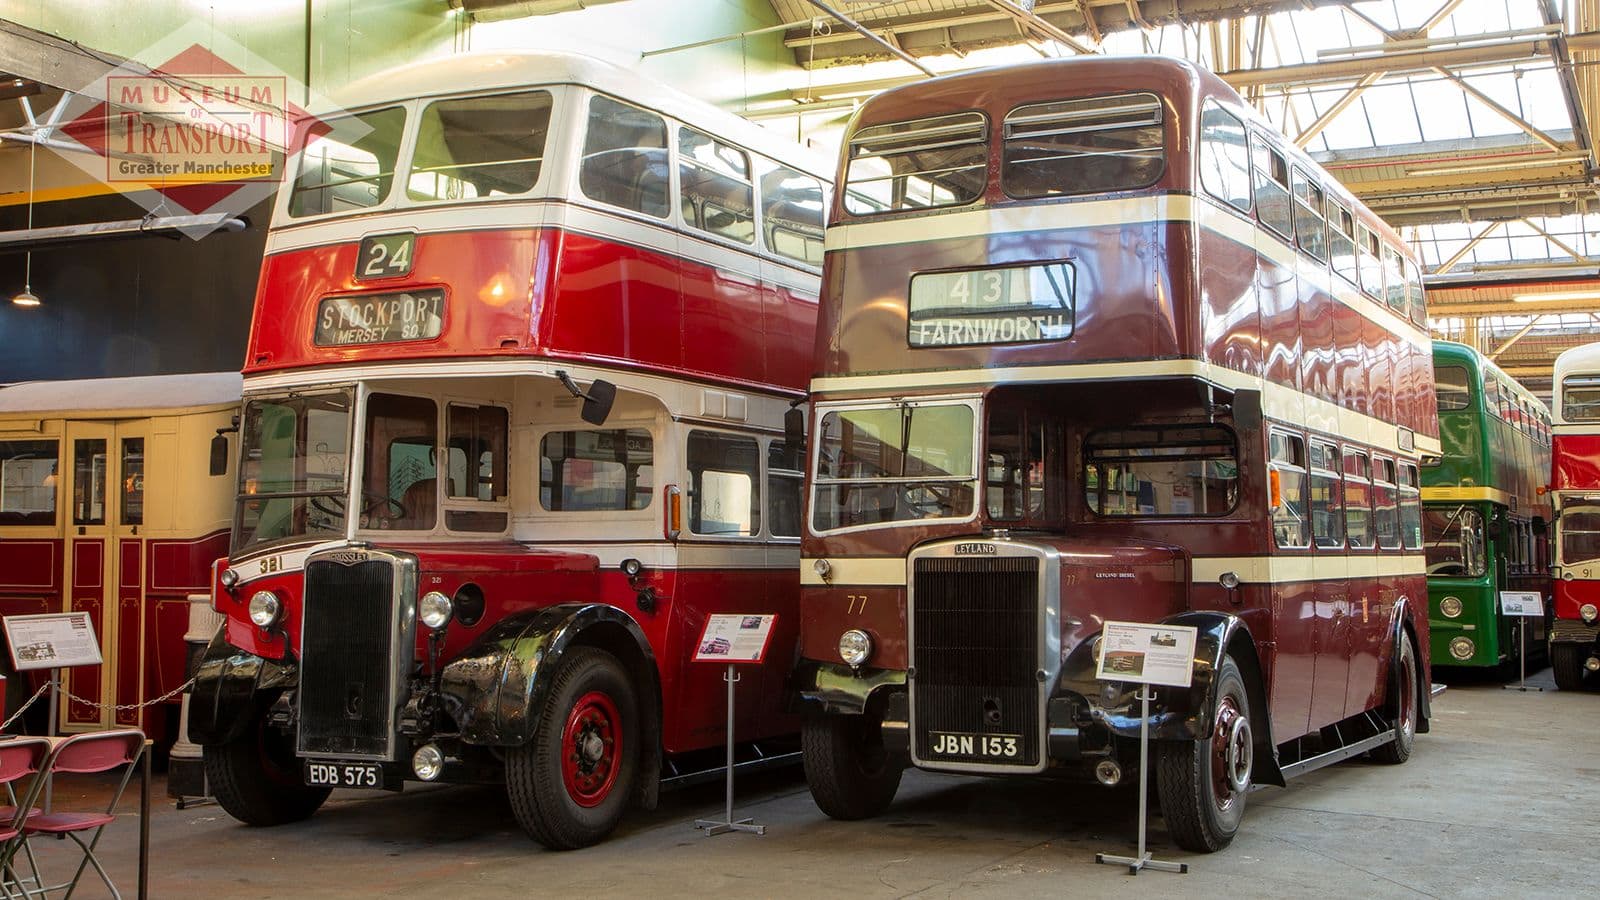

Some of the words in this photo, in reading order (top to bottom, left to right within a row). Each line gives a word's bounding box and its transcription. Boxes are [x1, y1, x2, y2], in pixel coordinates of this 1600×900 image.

[364, 240, 410, 276] 24
[323, 296, 442, 330] STOCKPORT
[919, 314, 1063, 345] FARNWORTH
[955, 543, 996, 554] LEYLAND
[847, 595, 868, 615] 77
[933, 735, 974, 754] JBN
[981, 737, 1017, 757] 153
[309, 764, 339, 784] EDB
[344, 766, 377, 786] 575
